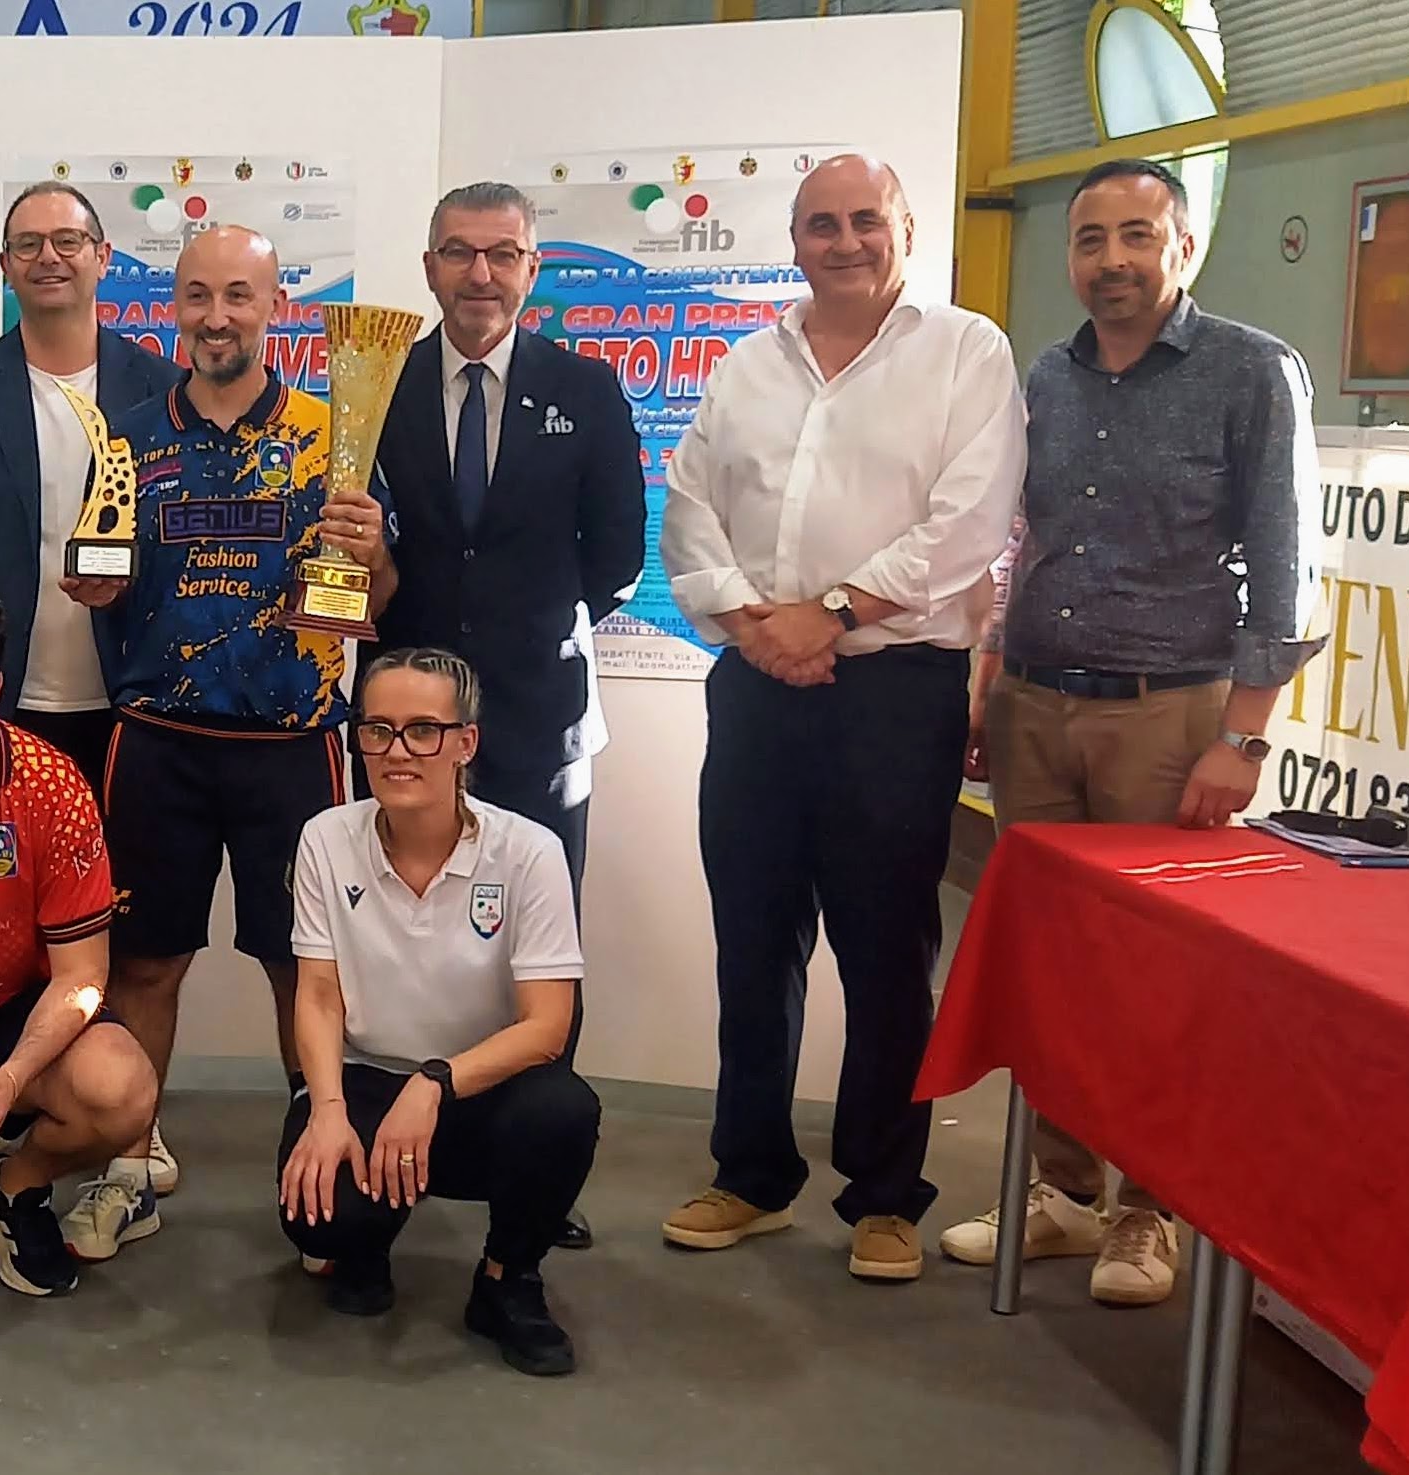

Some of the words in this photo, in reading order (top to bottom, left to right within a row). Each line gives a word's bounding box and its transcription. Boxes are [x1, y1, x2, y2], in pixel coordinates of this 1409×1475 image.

[680, 219, 736, 251] fib
[97, 302, 177, 329] RAN
[562, 305, 674, 333] GRAN
[544, 416, 574, 434] fib
[166, 503, 281, 529] GENIUS
[1321, 483, 1386, 542] UTO
[185, 545, 258, 568] Fashion
[176, 573, 251, 598] Service
[596, 625, 641, 635] CANALE
[1279, 748, 1358, 818] 0721
